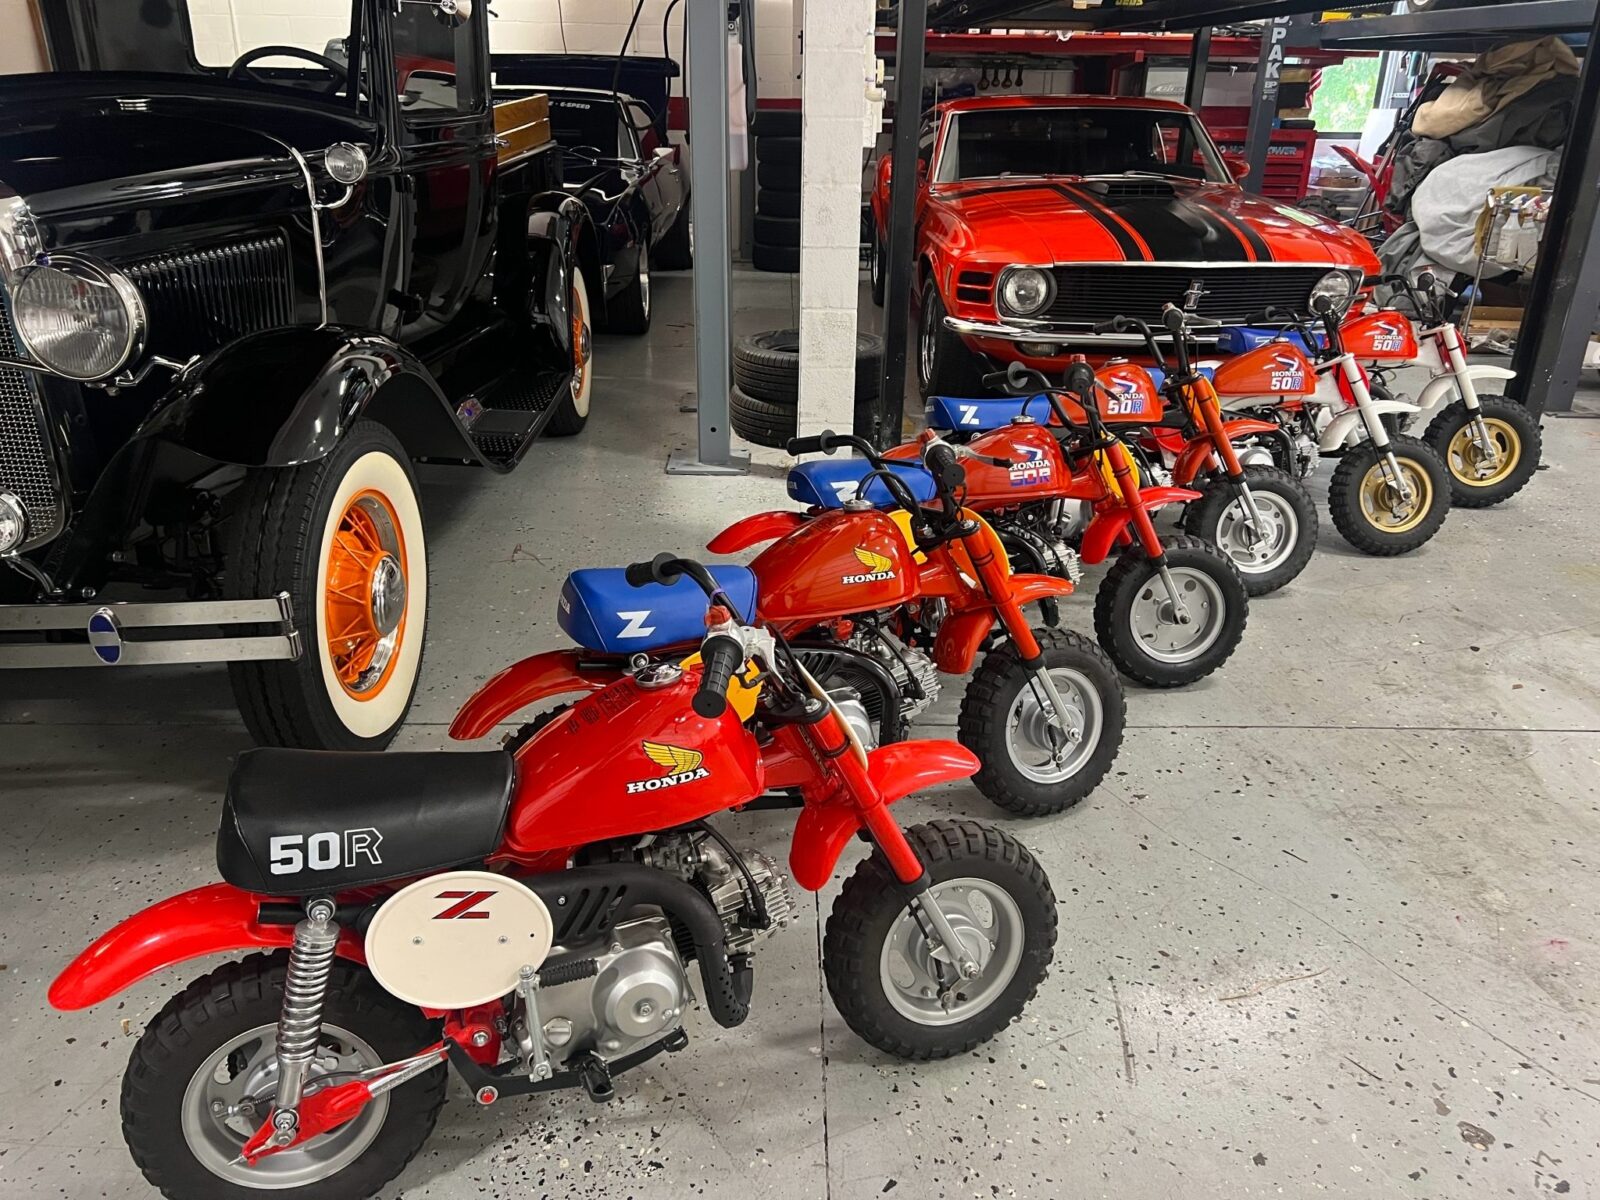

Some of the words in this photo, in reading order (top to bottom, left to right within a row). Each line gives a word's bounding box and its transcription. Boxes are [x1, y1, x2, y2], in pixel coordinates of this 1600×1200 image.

[560, 101, 591, 110] 6-SPEED
[1270, 377, 1302, 390] 50R
[960, 405, 980, 425] Z
[1107, 399, 1143, 415] 50R
[1010, 467, 1051, 488] 50R
[842, 571, 896, 585] HONDA
[616, 610, 656, 639] Z
[626, 768, 710, 794] HONDA
[270, 827, 384, 876] 50R
[431, 890, 499, 920] Z
